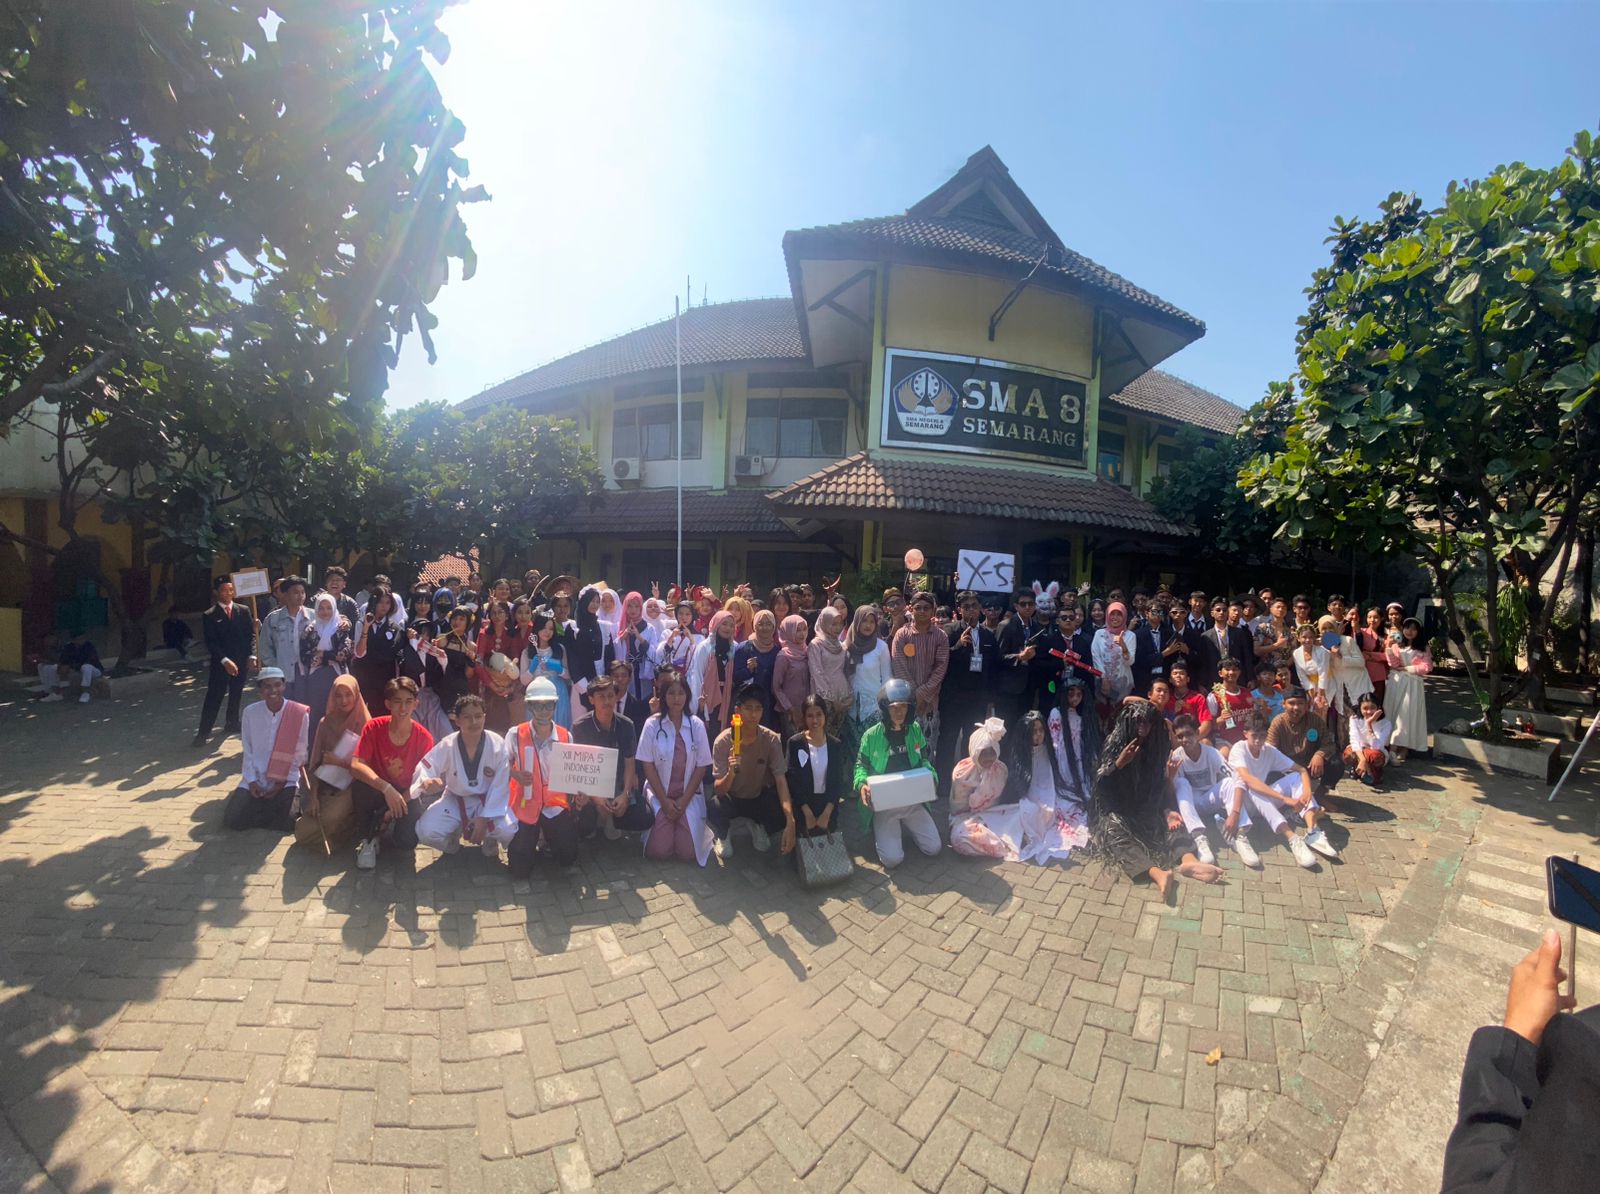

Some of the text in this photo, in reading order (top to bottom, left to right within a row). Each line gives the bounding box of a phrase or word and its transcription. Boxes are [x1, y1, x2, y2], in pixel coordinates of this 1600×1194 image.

[962, 378, 1081, 424] SMA 8
[905, 421, 944, 430] SEMARANG
[963, 418, 1076, 447] SEMARANG
[573, 751, 594, 762] MIPA
[597, 753, 604, 764] 5
[563, 762, 601, 774] INDONESIA
